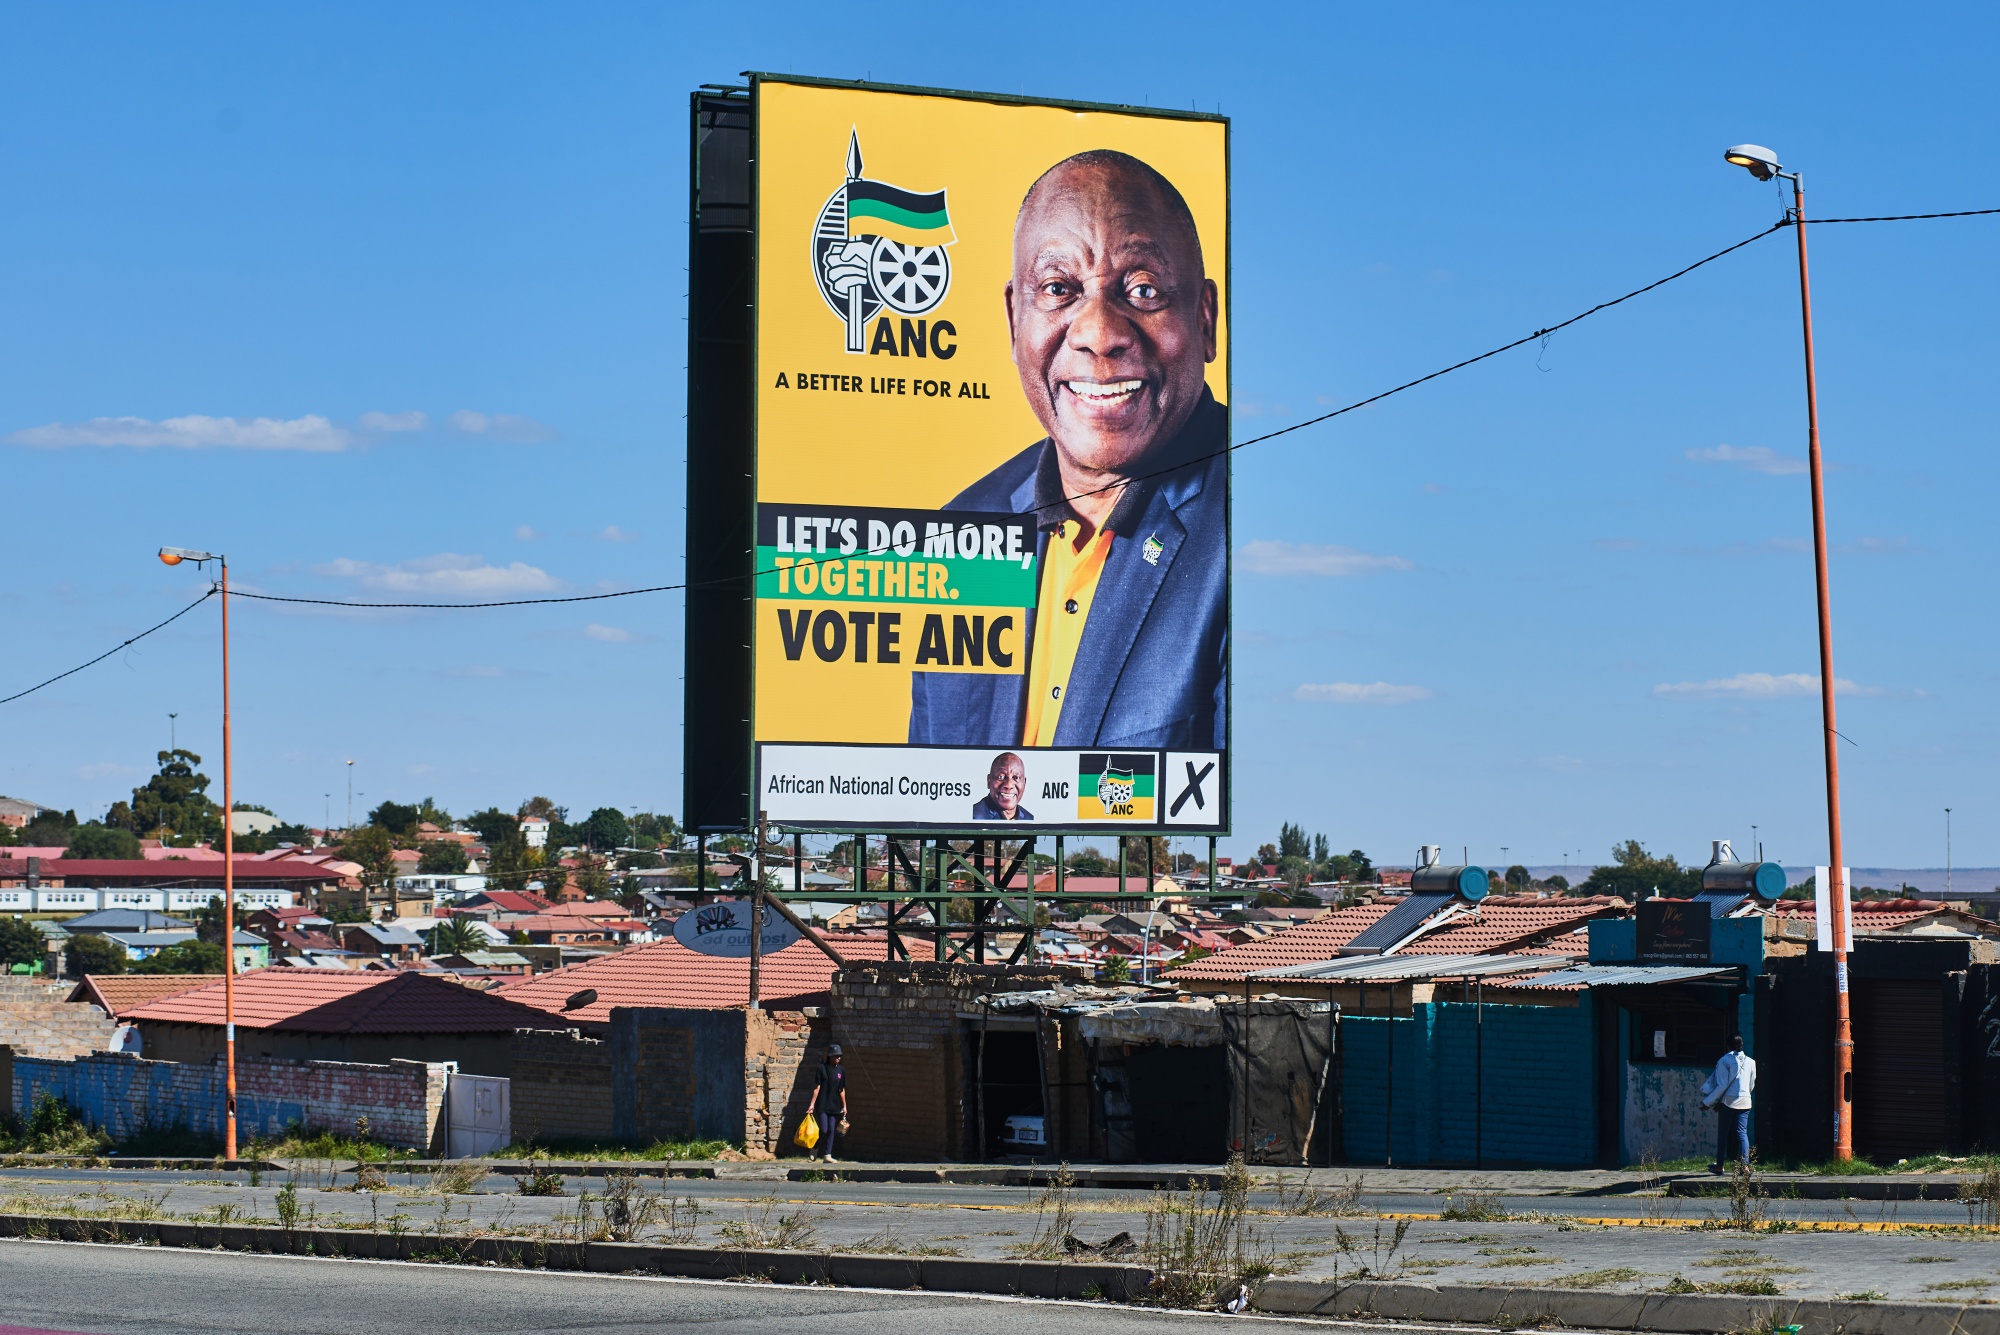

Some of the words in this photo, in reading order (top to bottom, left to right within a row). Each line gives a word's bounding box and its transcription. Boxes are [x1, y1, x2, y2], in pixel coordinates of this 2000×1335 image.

[870, 317, 957, 360] ANC
[775, 372, 790, 389] A
[797, 373, 863, 393] BETTER
[871, 377, 906, 395] LIFE
[913, 379, 952, 397] FOR
[958, 382, 990, 399] ALL
[777, 515, 858, 555] LET'S
[868, 519, 917, 557] DO
[923, 522, 1034, 570] MORE,
[775, 557, 960, 600] TOGETHER.
[777, 609, 901, 664] VOTE
[915, 613, 1013, 668] ANC
[768, 775, 824, 794] African
[829, 775, 894, 795] National
[898, 776, 971, 800] Congress
[1042, 782, 1069, 799] ANC
[1111, 804, 1134, 815] ANC
[703, 934, 724, 944] ad
[727, 933, 787, 945] outost
